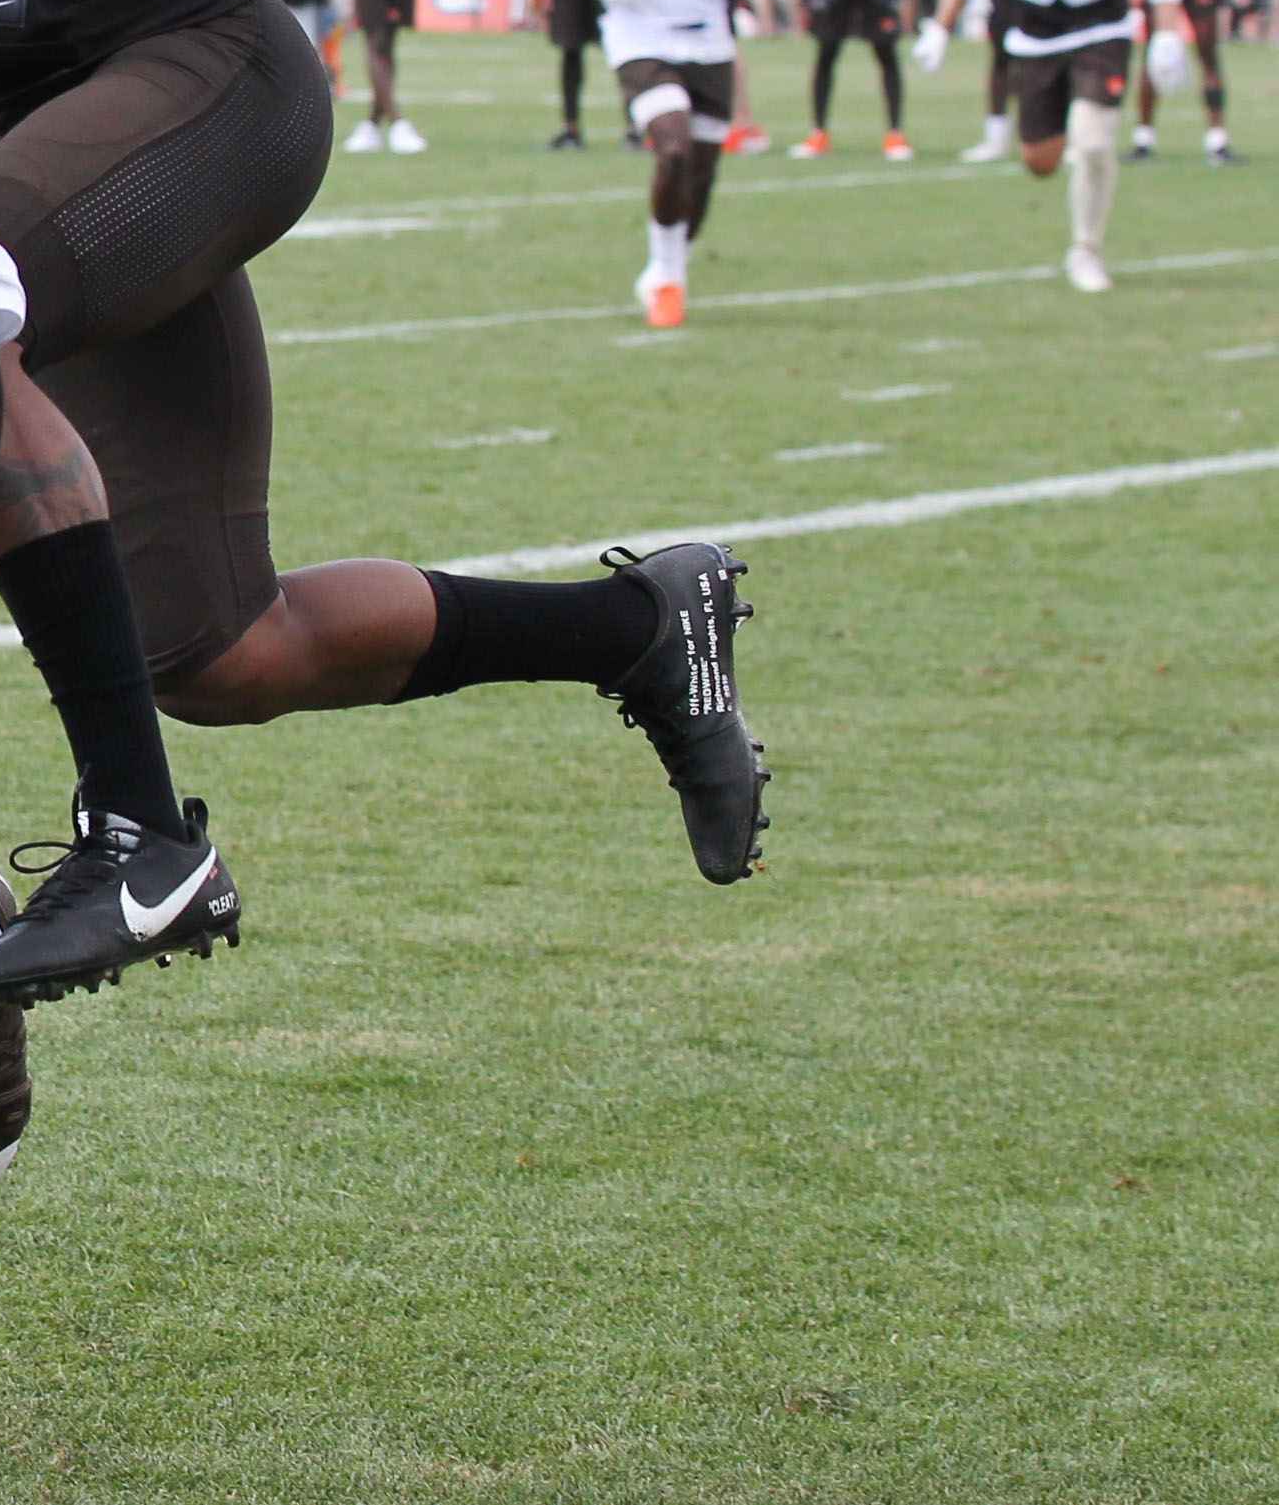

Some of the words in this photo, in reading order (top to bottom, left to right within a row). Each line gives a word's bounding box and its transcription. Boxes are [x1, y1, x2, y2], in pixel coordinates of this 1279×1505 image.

[698, 572, 712, 596] USA
[703, 598, 714, 613] FL
[679, 609, 693, 635] NIKE
[686, 638, 696, 655] for
[710, 661, 726, 713] Richmond
